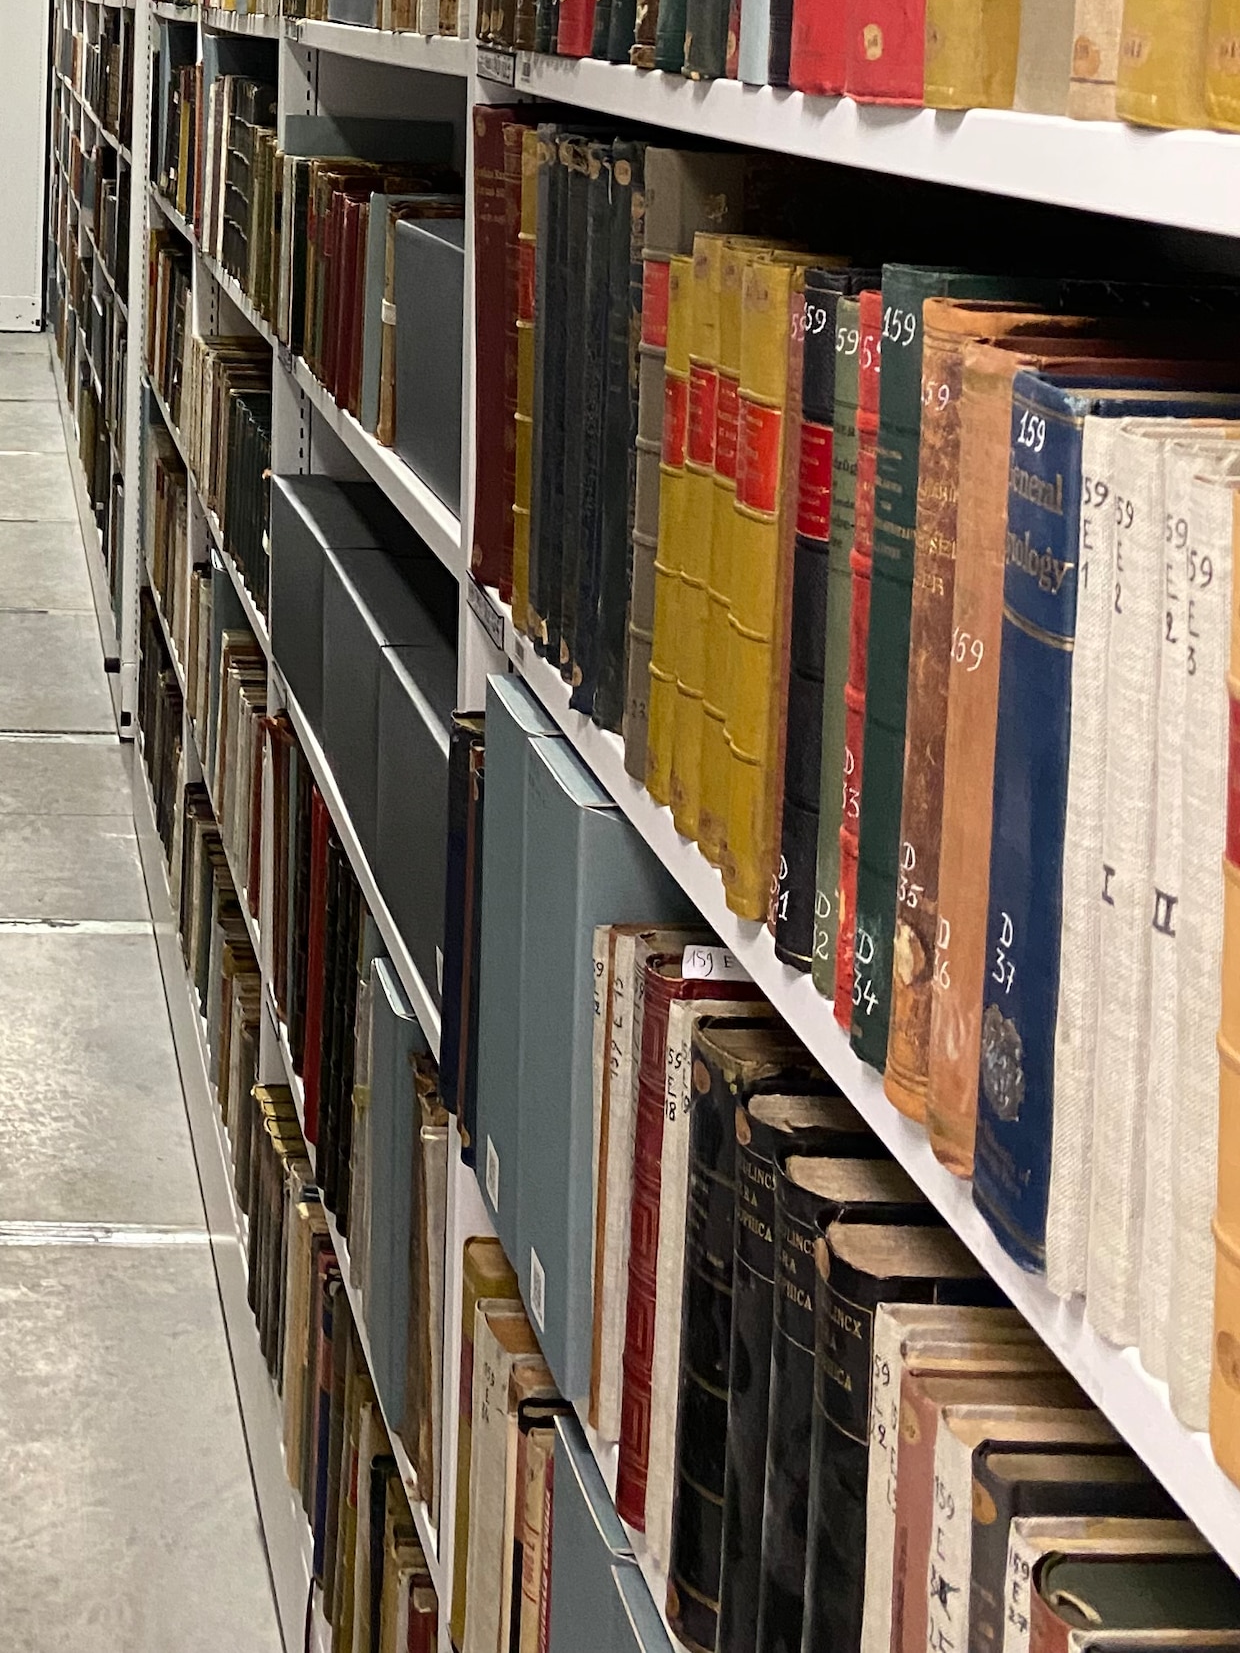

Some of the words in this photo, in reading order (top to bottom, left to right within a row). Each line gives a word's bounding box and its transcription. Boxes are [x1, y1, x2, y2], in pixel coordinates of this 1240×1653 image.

[882, 305, 916, 346] 159
[1017, 410, 1047, 452] 159
[902, 842, 916, 871] D
[815, 889, 831, 919] D
[858, 927, 875, 964] D
[936, 914, 950, 950] D
[998, 912, 1014, 948] D
[685, 950, 714, 977] 159
[724, 954, 734, 968] E
[992, 948, 1016, 994] 37
